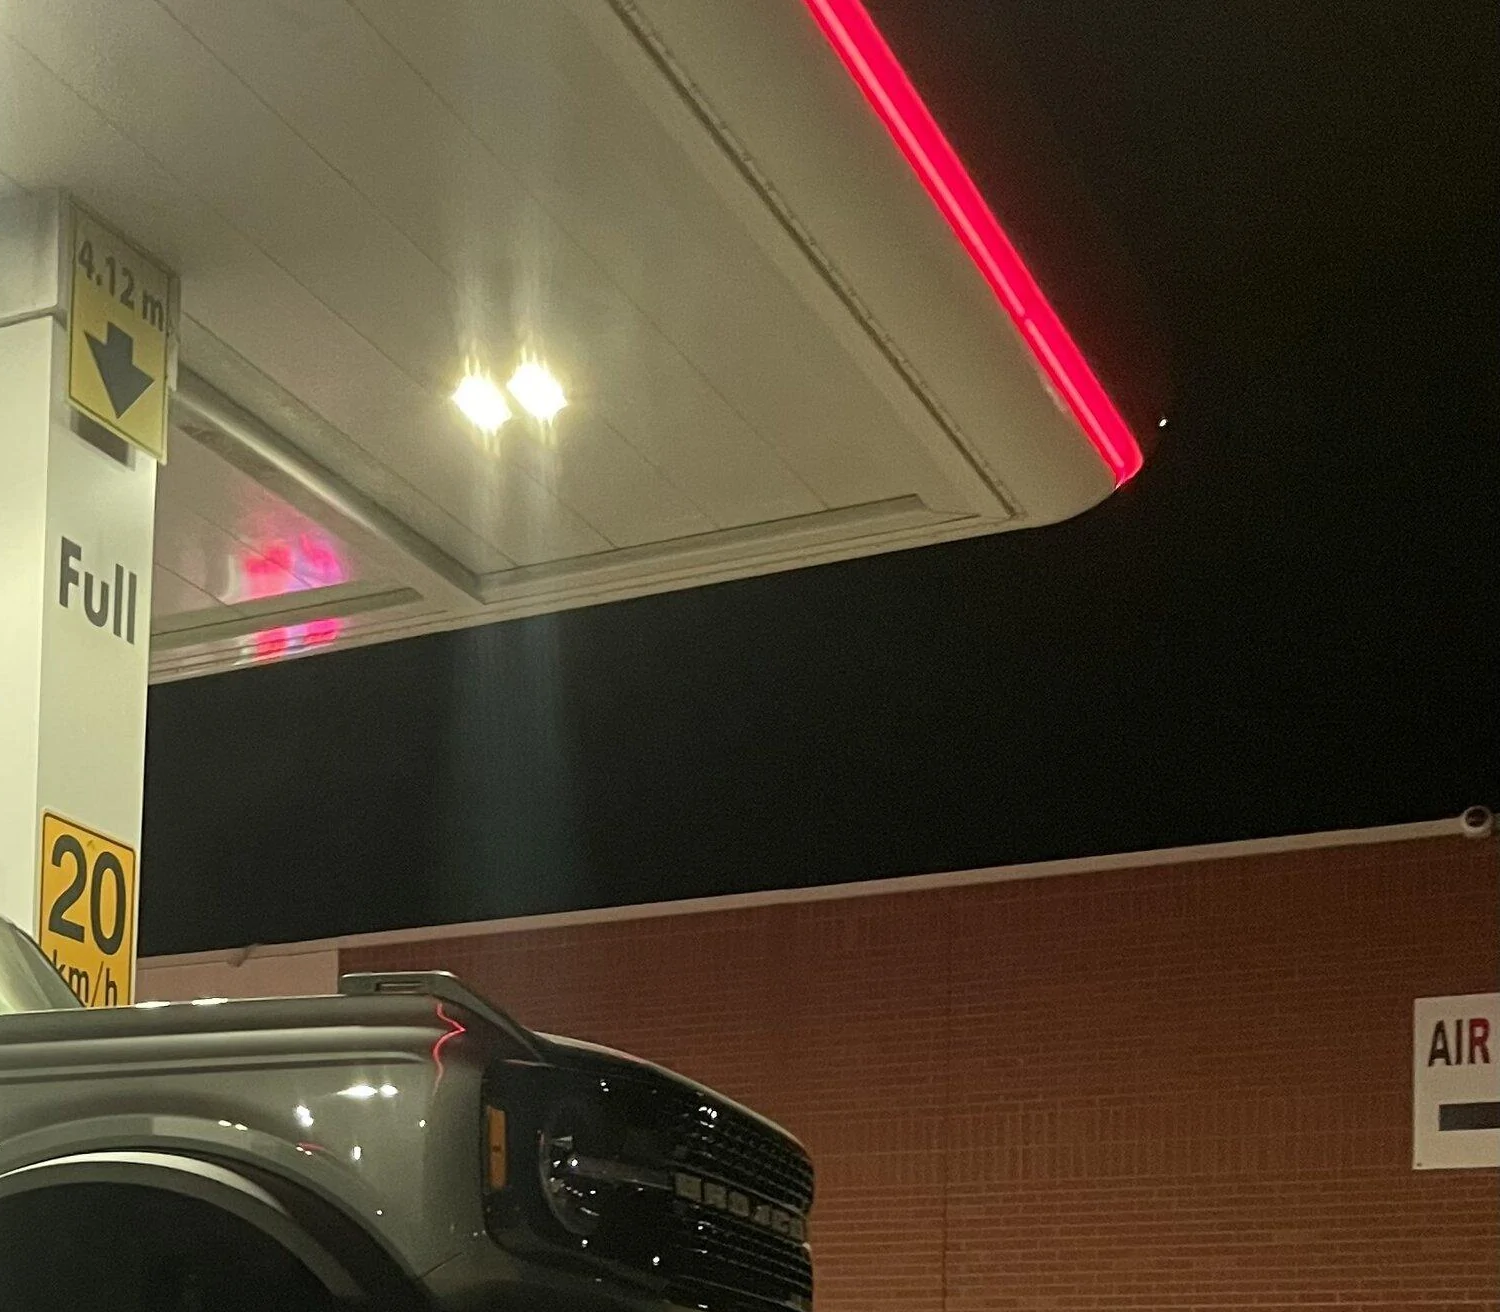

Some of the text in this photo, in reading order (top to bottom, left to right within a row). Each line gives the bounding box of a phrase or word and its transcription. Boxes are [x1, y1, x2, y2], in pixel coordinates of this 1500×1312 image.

[77, 240, 164, 332] 4.12 m
[59, 536, 137, 645] Full
[48, 834, 126, 955] 20
[1428, 1018, 1490, 1067] AIR
